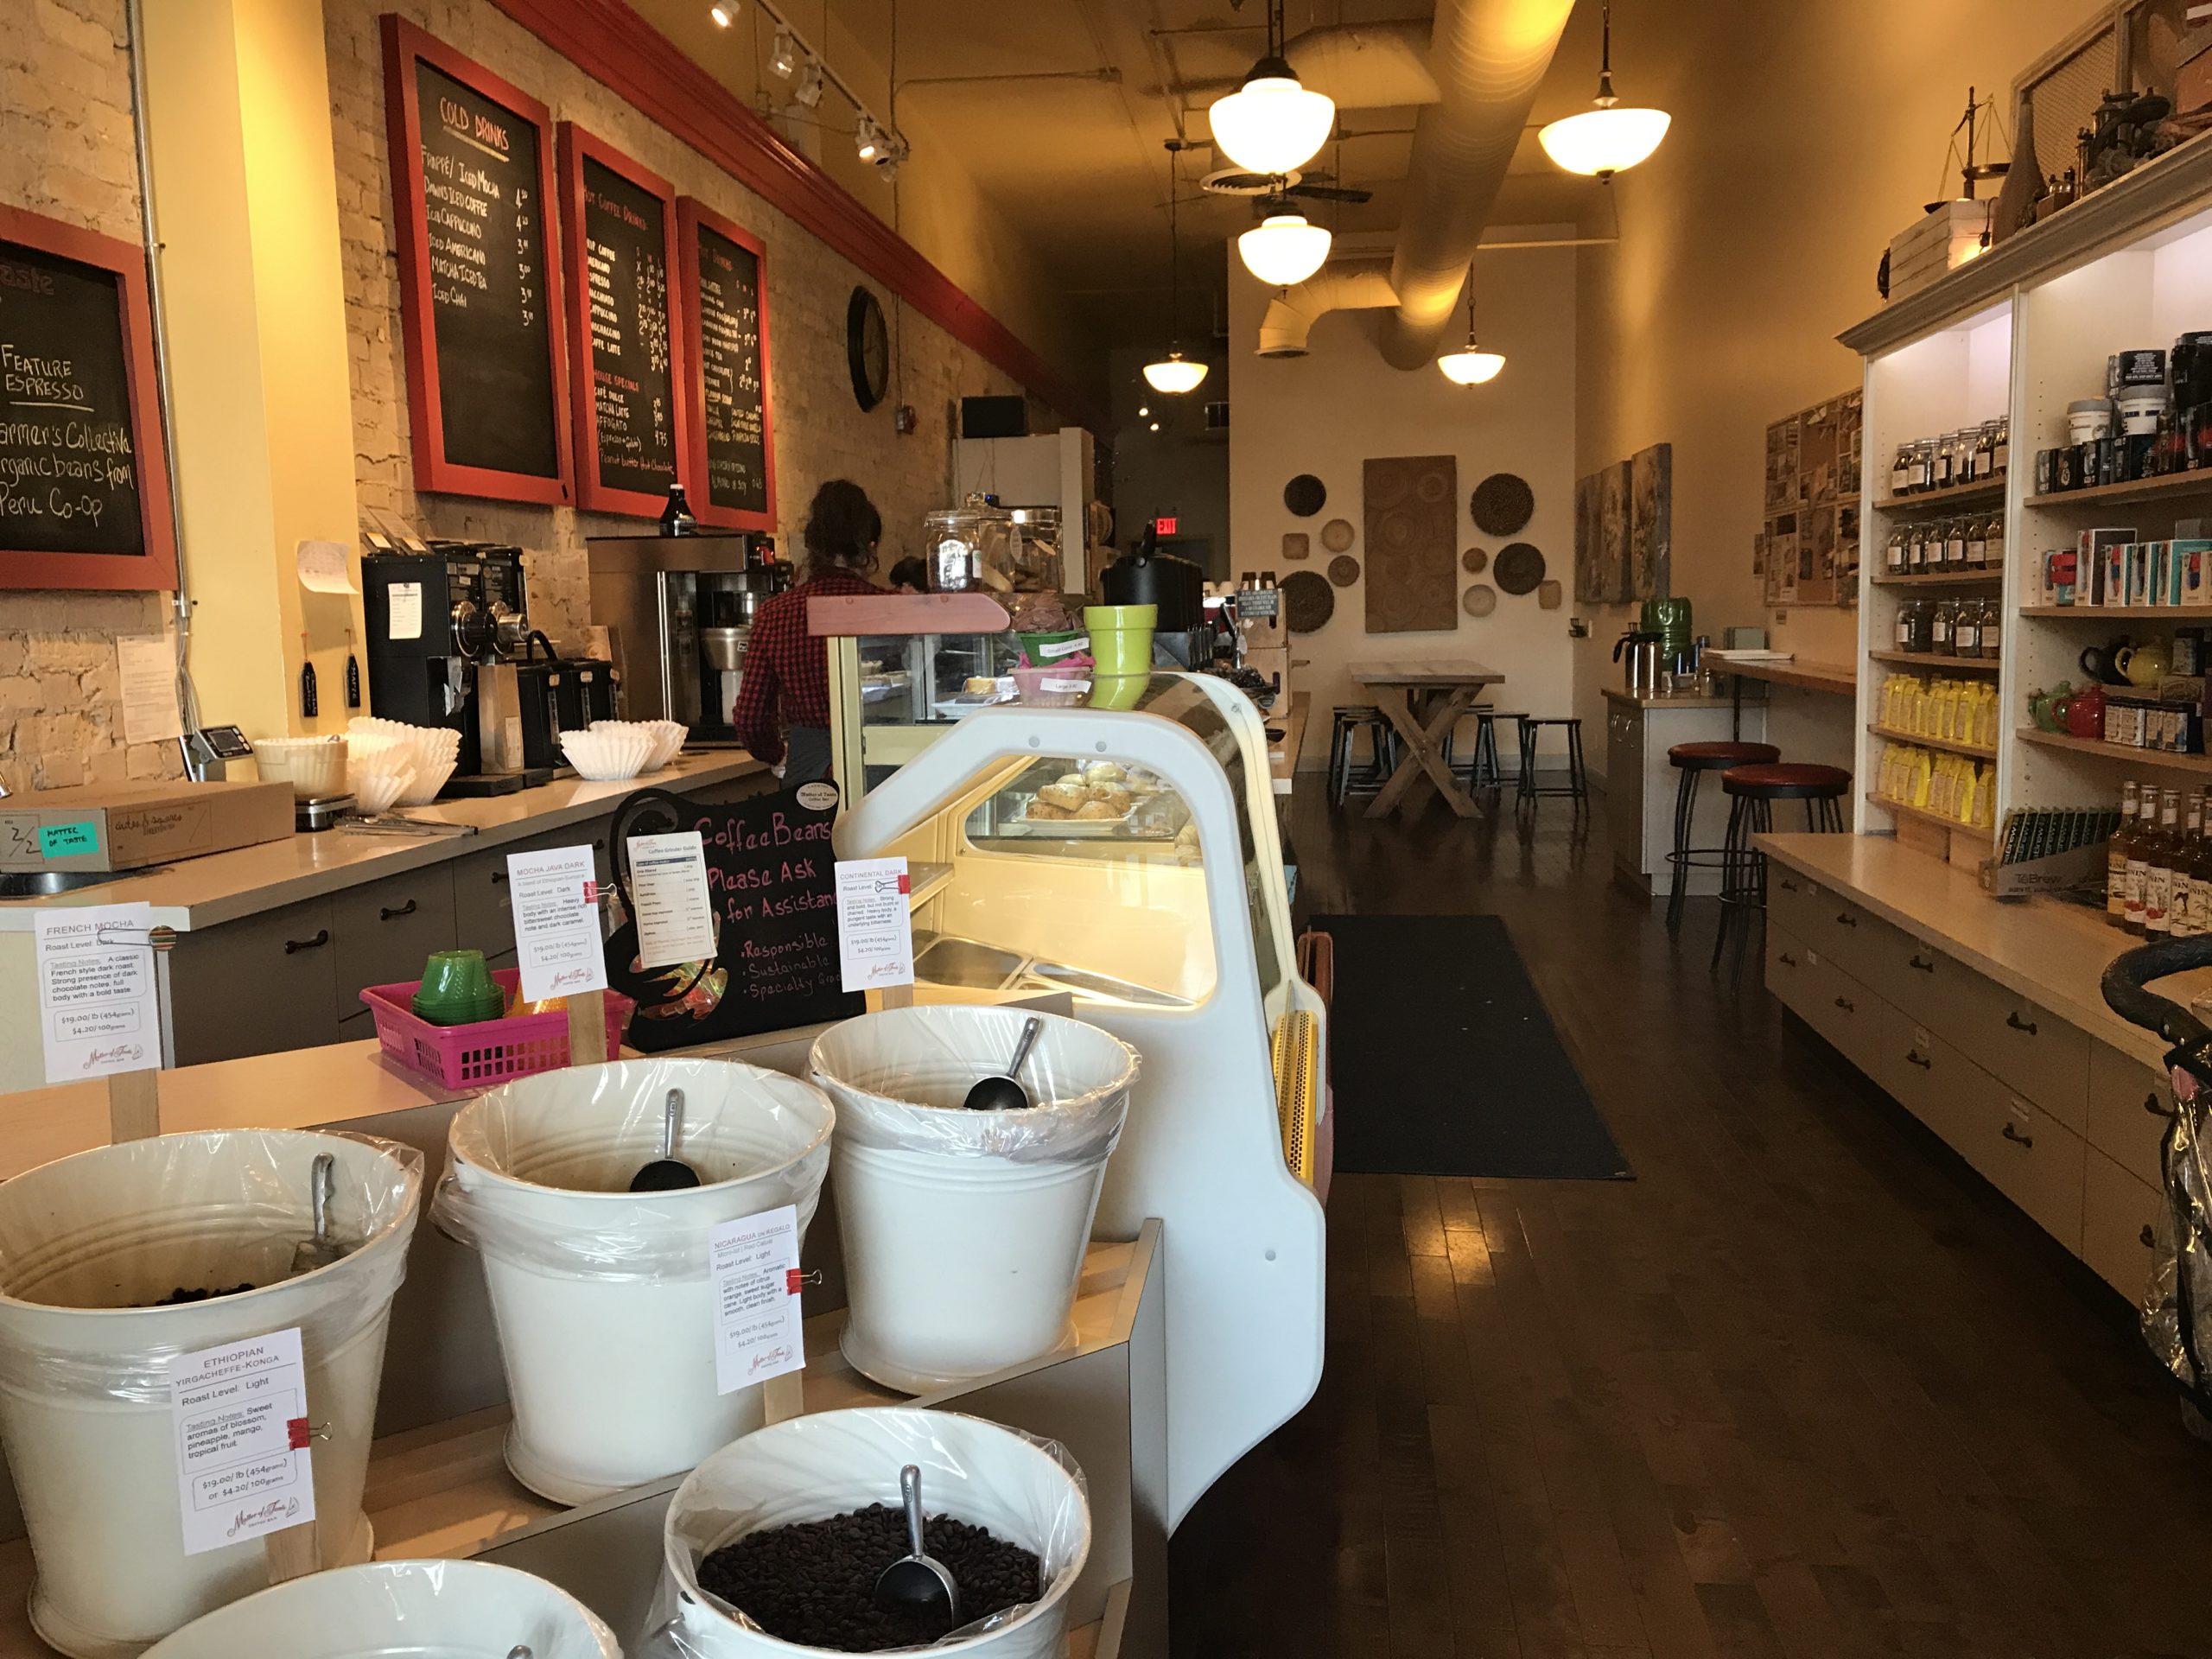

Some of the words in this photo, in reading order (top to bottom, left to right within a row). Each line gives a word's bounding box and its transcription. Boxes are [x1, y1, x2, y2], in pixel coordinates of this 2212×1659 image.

[441, 97, 468, 130] COLD
[475, 115, 510, 150] DRINKS
[589, 272, 610, 289] SPRESSO
[3, 345, 71, 377] FEATURE
[6, 373, 84, 401] ESPRESSO
[0, 422, 61, 447] armer's
[0, 456, 51, 487] rganic
[54, 455, 104, 482] beans
[106, 460, 133, 491] from
[0, 481, 42, 518] Peru
[49, 487, 102, 527] Co-Op
[1157, 518, 1176, 533] EXIT
[693, 817, 771, 855] Coffee
[772, 812, 831, 846] Beans
[517, 866, 544, 876] MOCHA
[564, 861, 585, 869] DARK
[708, 866, 772, 893] Please
[780, 858, 816, 882] Ask
[840, 872, 883, 880] CONTINENTAL
[518, 890, 537, 899] Roast
[727, 897, 752, 922] for
[762, 891, 837, 917] Assistan
[47, 925, 92, 935] FRENCH
[95, 920, 134, 931] MOCHA
[524, 916, 553, 925] bittersweet
[554, 912, 579, 920] chocolate
[744, 933, 829, 958] Responsible
[50, 960, 77, 969] Tasting
[51, 968, 76, 977] French
[79, 966, 96, 975] style
[750, 955, 830, 981] Sustainable
[52, 976, 76, 986] Strong
[79, 974, 111, 982] presence
[52, 984, 87, 993] chocolate
[750, 976, 814, 1001] Specialty
[715, 1232, 756, 1249] NICARAGUA
[766, 1224, 791, 1236] REGALO
[716, 1261, 734, 1272] Roast
[756, 1250, 771, 1261] Light
[722, 1286, 734, 1294] with
[734, 1281, 749, 1291] notes
[744, 1287, 760, 1295] sweet
[760, 1281, 775, 1294] sugar
[753, 1291, 766, 1302] body
[204, 1346, 264, 1368] ETHIOPIAN
[181, 1393, 211, 1407] Roast
[246, 1376, 269, 1392] Light
[187, 1417, 216, 1433] Tasting
[246, 1402, 272, 1415] Sweet
[187, 1428, 218, 1441] aromas
[220, 1422, 228, 1432] of
[188, 1444, 219, 1459] tropical
[235, 1471, 244, 1479] lb
